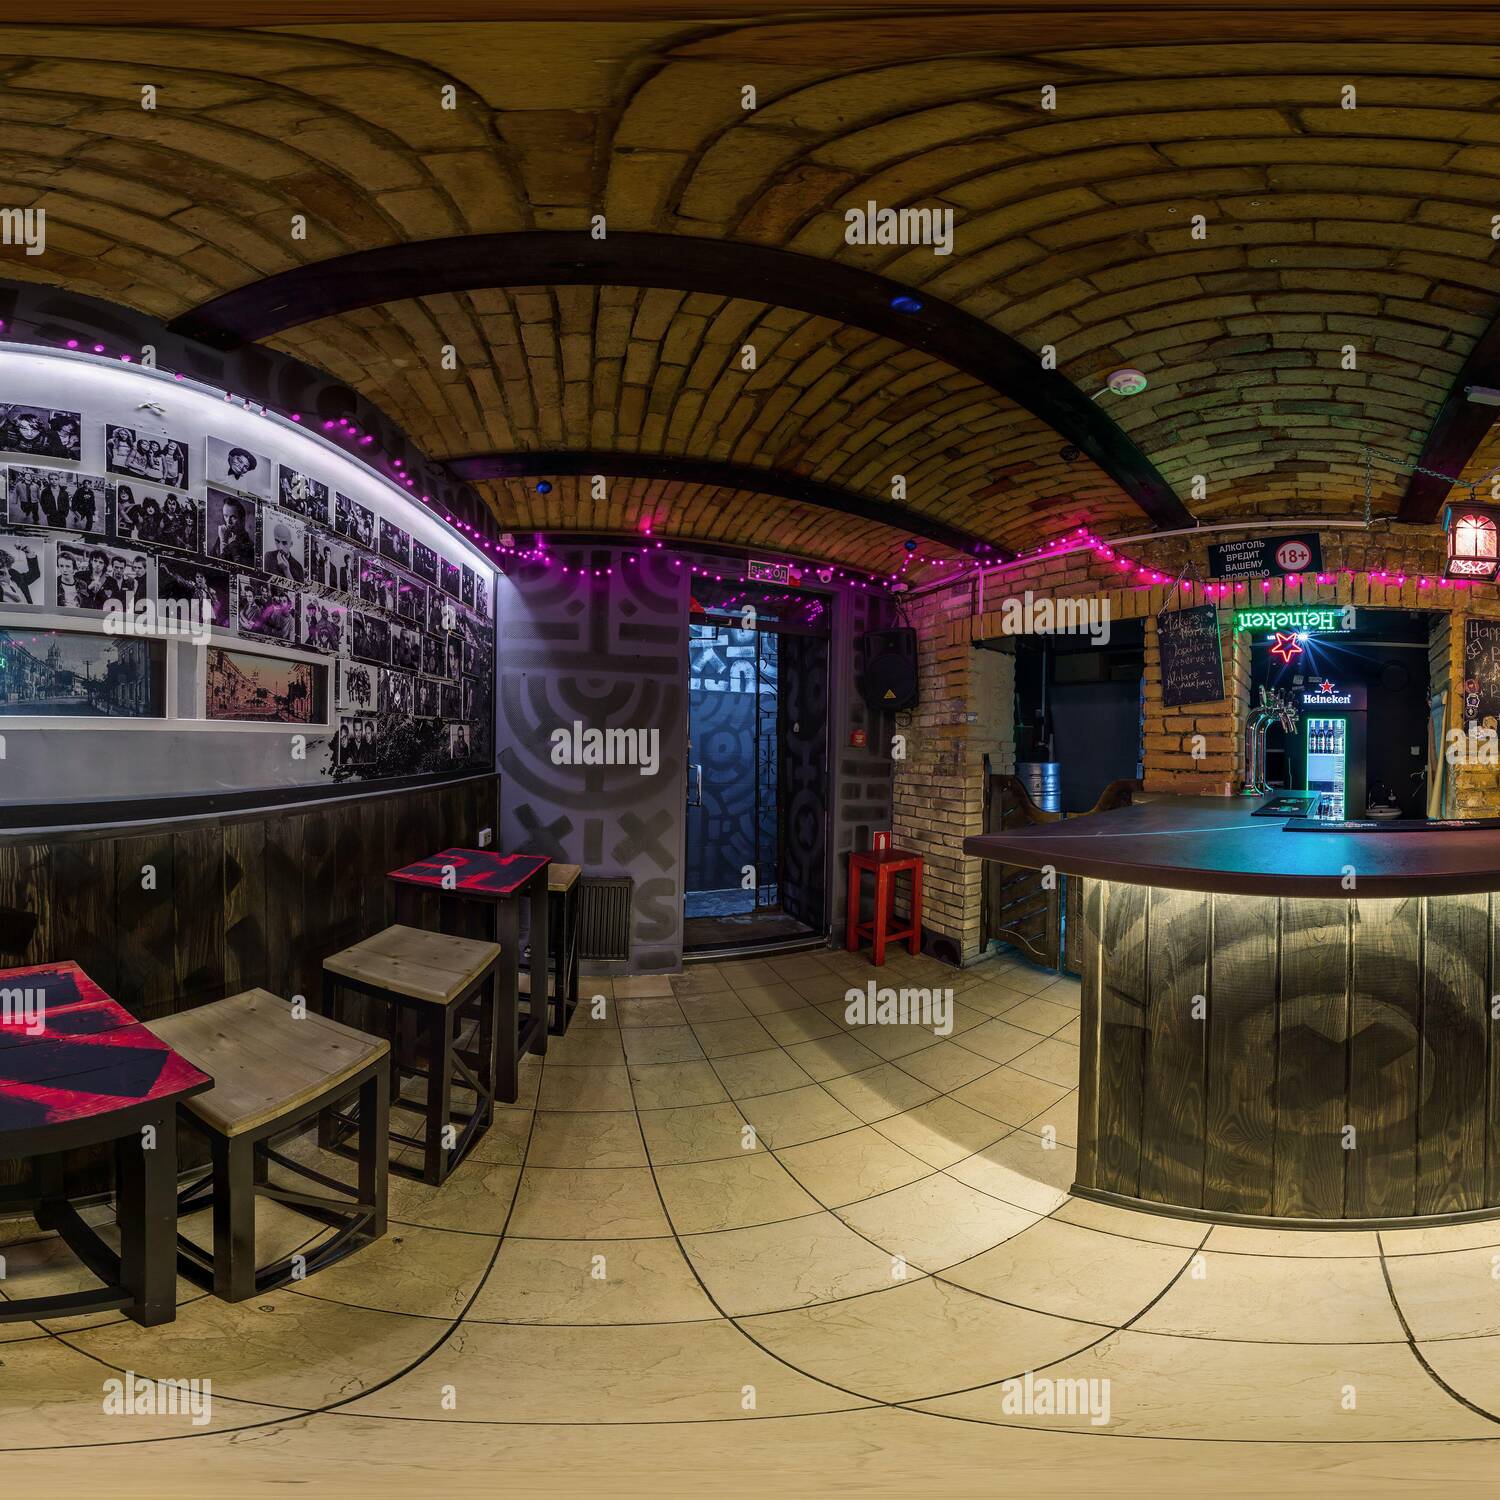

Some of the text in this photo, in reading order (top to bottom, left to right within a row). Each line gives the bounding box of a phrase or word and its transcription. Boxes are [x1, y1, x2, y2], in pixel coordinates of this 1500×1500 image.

[1219, 541, 1265, 553] АЛКОГОЛЬ
[1226, 551, 1260, 562] ВРЕДИТ
[1280, 550, 1307, 564] 18+
[1225, 560, 1263, 572] ВАШЕМУ
[1238, 611, 1335, 631] Heineken
[1466, 637, 1483, 660] SET
[1303, 694, 1351, 704] Heineken
